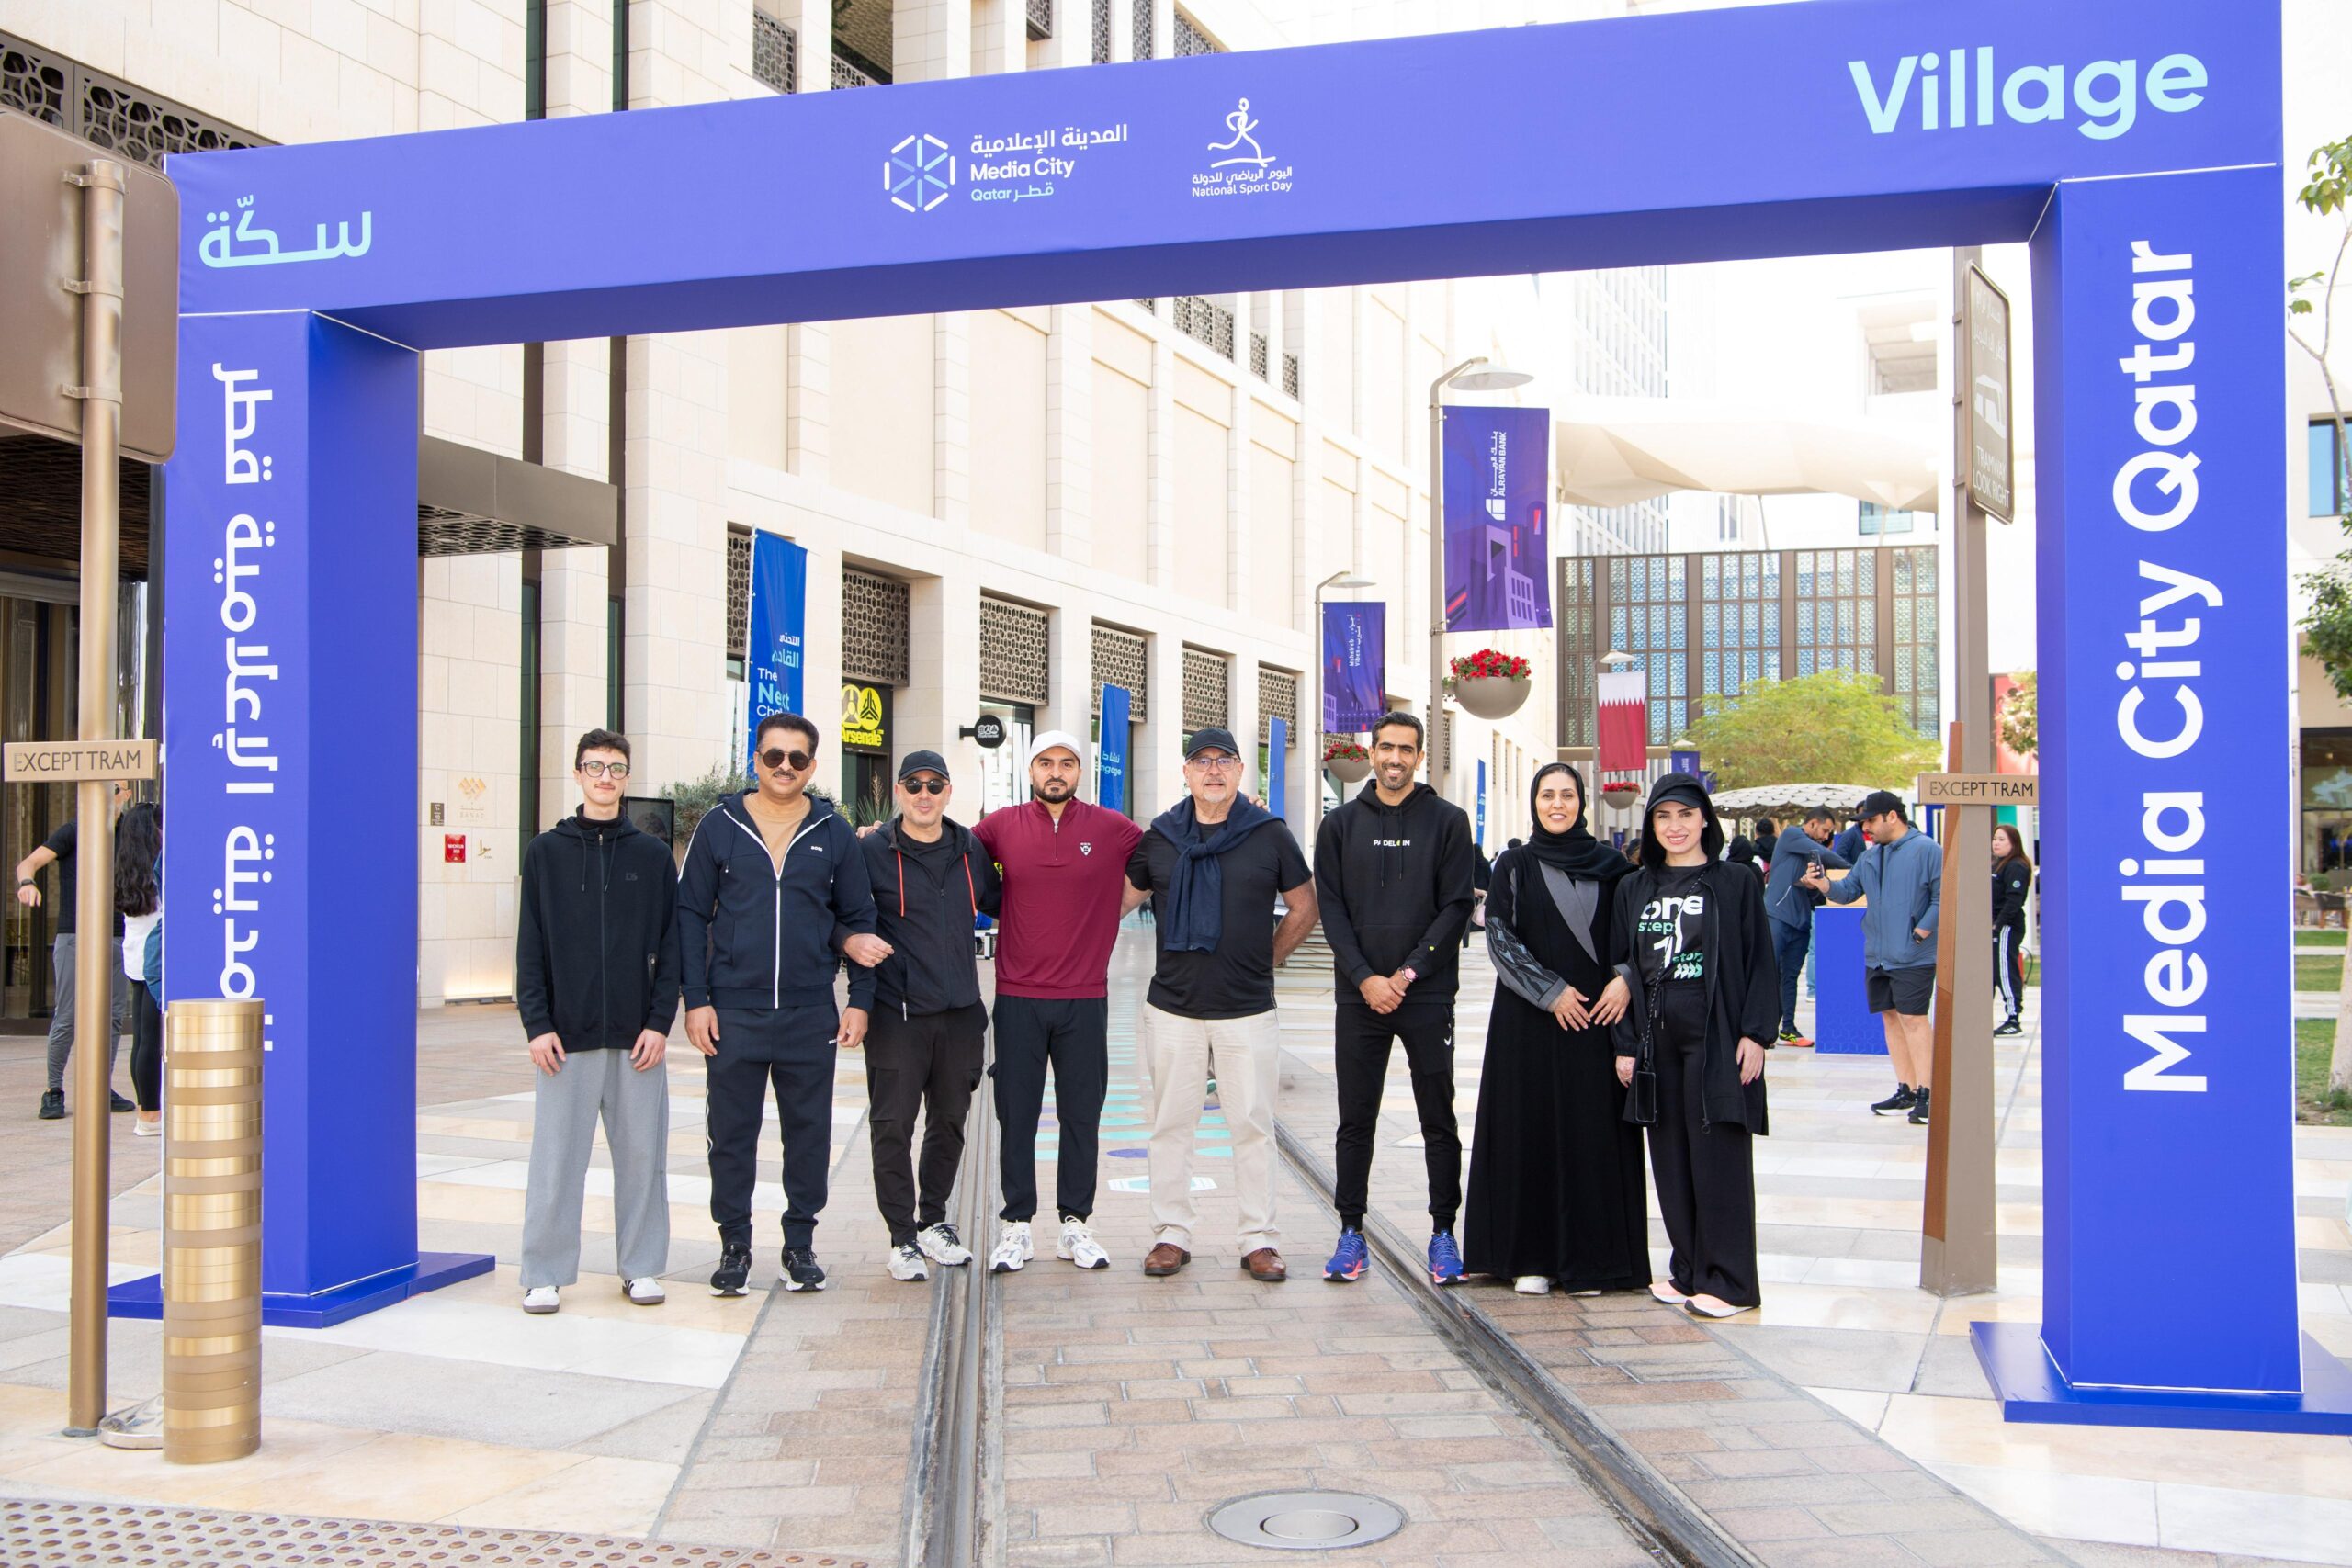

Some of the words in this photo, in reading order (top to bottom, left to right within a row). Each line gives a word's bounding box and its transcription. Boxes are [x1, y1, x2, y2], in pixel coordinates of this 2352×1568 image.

[1848, 45, 2209, 141] Village
[970, 130, 1056, 158] الإعلامية
[1061, 123, 1128, 150] المدينة
[970, 160, 1031, 181] Media
[1034, 157, 1075, 178] City
[1192, 172, 1223, 186] للدولة
[1226, 168, 1264, 185] الرياضي
[1267, 166, 1293, 180] اليوم
[971, 188, 1012, 202] Qatar
[1013, 181, 1055, 203] قطر
[1192, 184, 1238, 197] National
[1239, 183, 1270, 195] Sport
[1272, 181, 1293, 192] Day
[2112, 240, 2203, 533] Qatar
[212, 362, 273, 484] قطر
[1498, 432, 1507, 456] BANK
[1973, 468, 1992, 498] LOOK
[1992, 480, 2010, 509] RIGHT
[212, 513, 279, 794] الإعلامية
[2115, 558, 2223, 759] City
[757, 668, 778, 682] The
[14, 751, 83, 773] EXCEPT
[86, 750, 141, 770] TRAM
[1929, 781, 1987, 797] EXCEPT
[1990, 782, 2033, 797] TRAM
[1640, 895, 1703, 920] one
[213, 825, 275, 1052] مدينة
[2120, 791, 2208, 1093] Media
